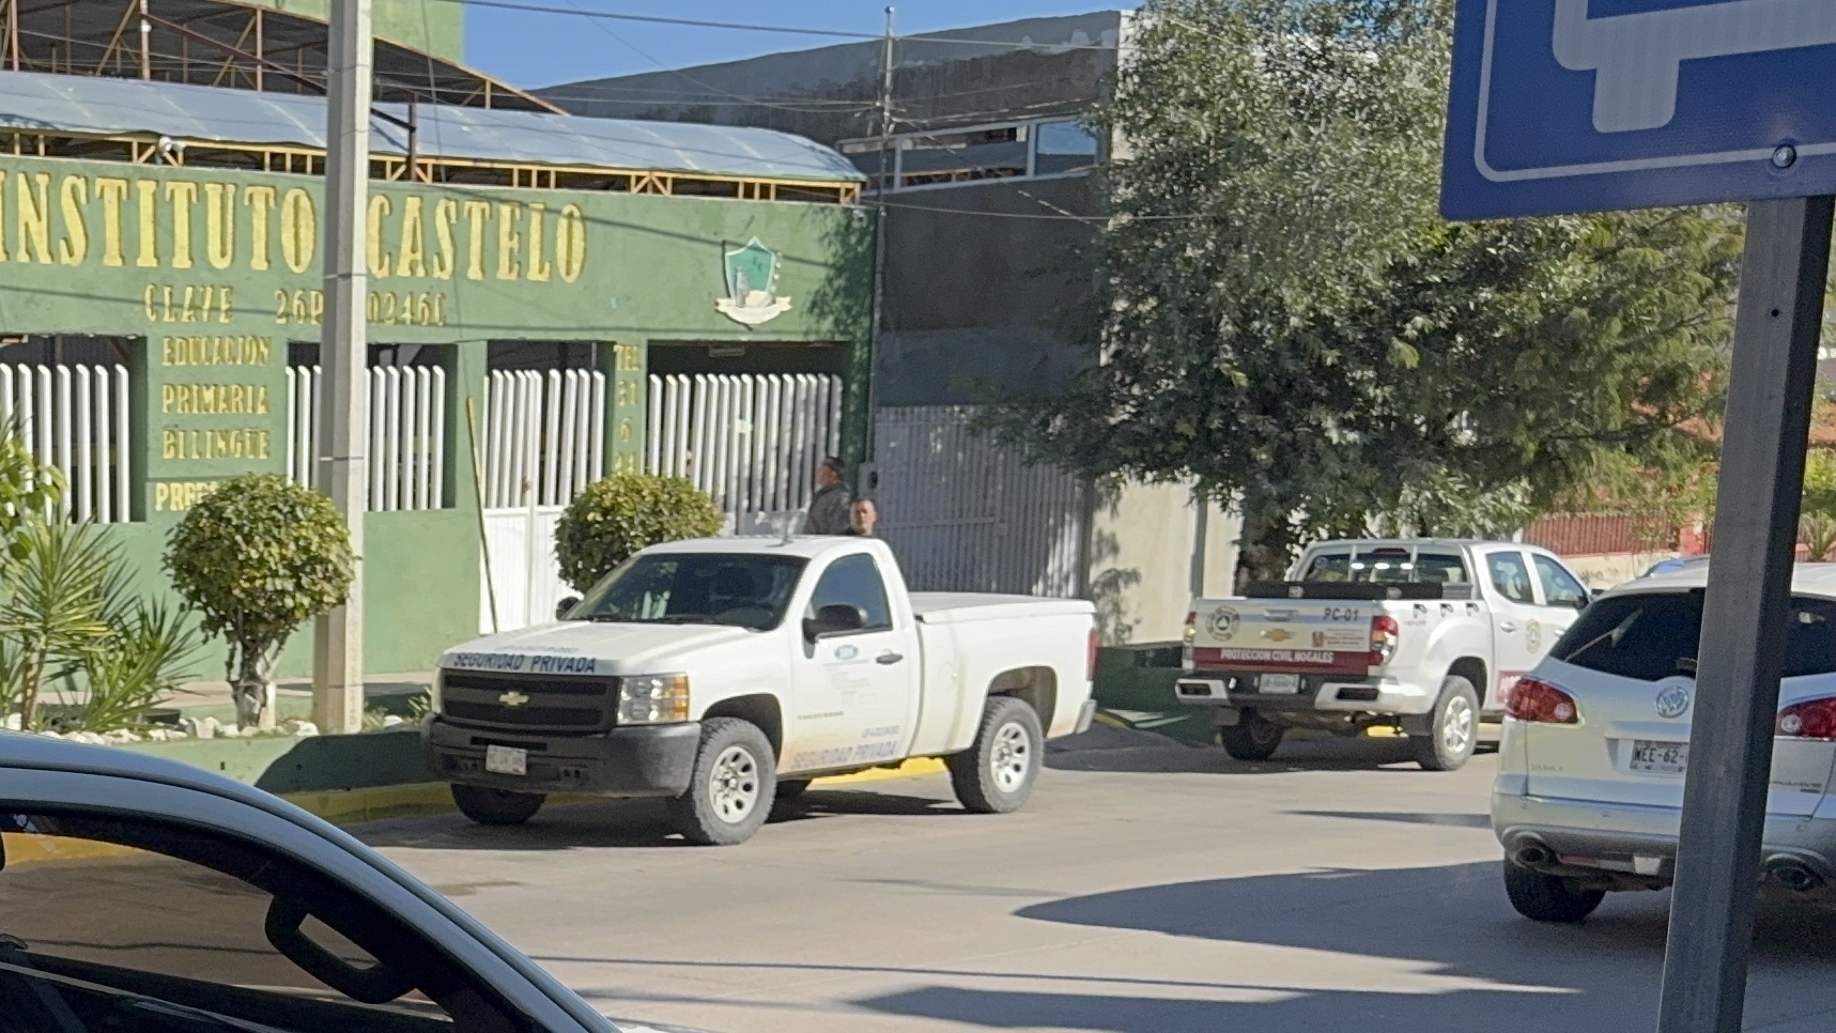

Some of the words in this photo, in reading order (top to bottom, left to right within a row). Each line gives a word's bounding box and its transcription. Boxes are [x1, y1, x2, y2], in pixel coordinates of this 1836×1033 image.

[367, 194, 588, 283] CASTELO
[145, 283, 233, 324] CLAVE
[162, 384, 270, 415] PRIMARIA
[454, 652, 525, 671] SEGURIDAD
[530, 655, 597, 673] PRIVADA
